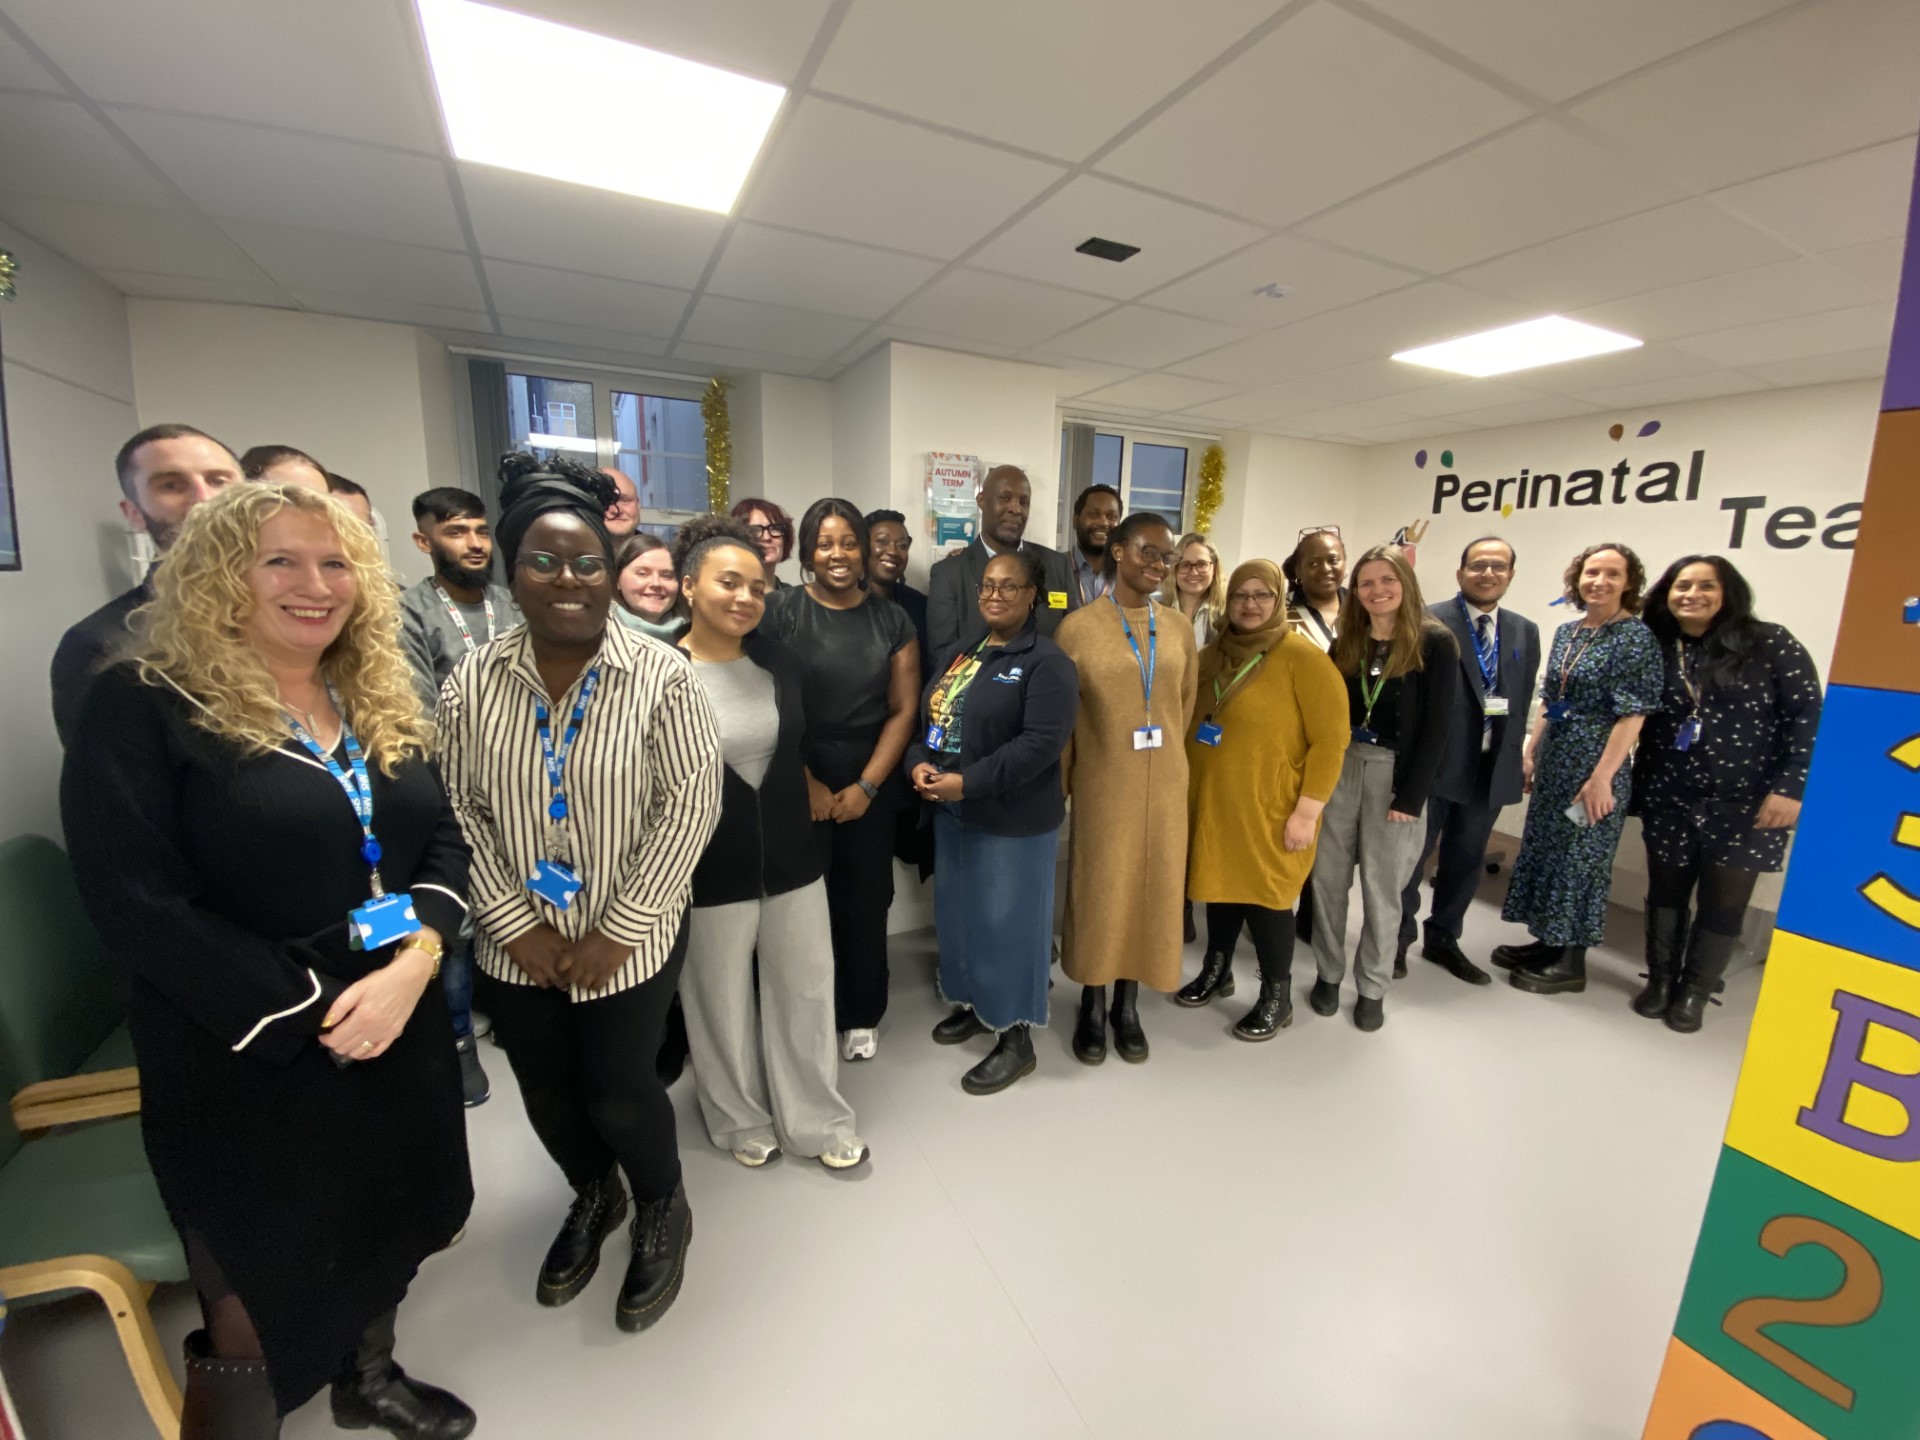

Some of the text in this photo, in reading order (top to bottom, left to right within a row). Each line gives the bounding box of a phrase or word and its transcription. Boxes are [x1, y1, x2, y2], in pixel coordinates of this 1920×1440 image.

[935, 468, 971, 478] AUTUMN
[942, 478, 965, 488] TERM
[1432, 449, 1705, 515] Perinatal
[578, 676, 596, 709] NHS NHS
[294, 727, 313, 744] NHS
[561, 743, 569, 758] NHS
[543, 737, 556, 772] NHS NHS
[337, 775, 354, 792] NHS
[358, 773, 373, 816] NHS NHS
[1796, 989, 1920, 1163] B
[1721, 1214, 1883, 1412] 2
